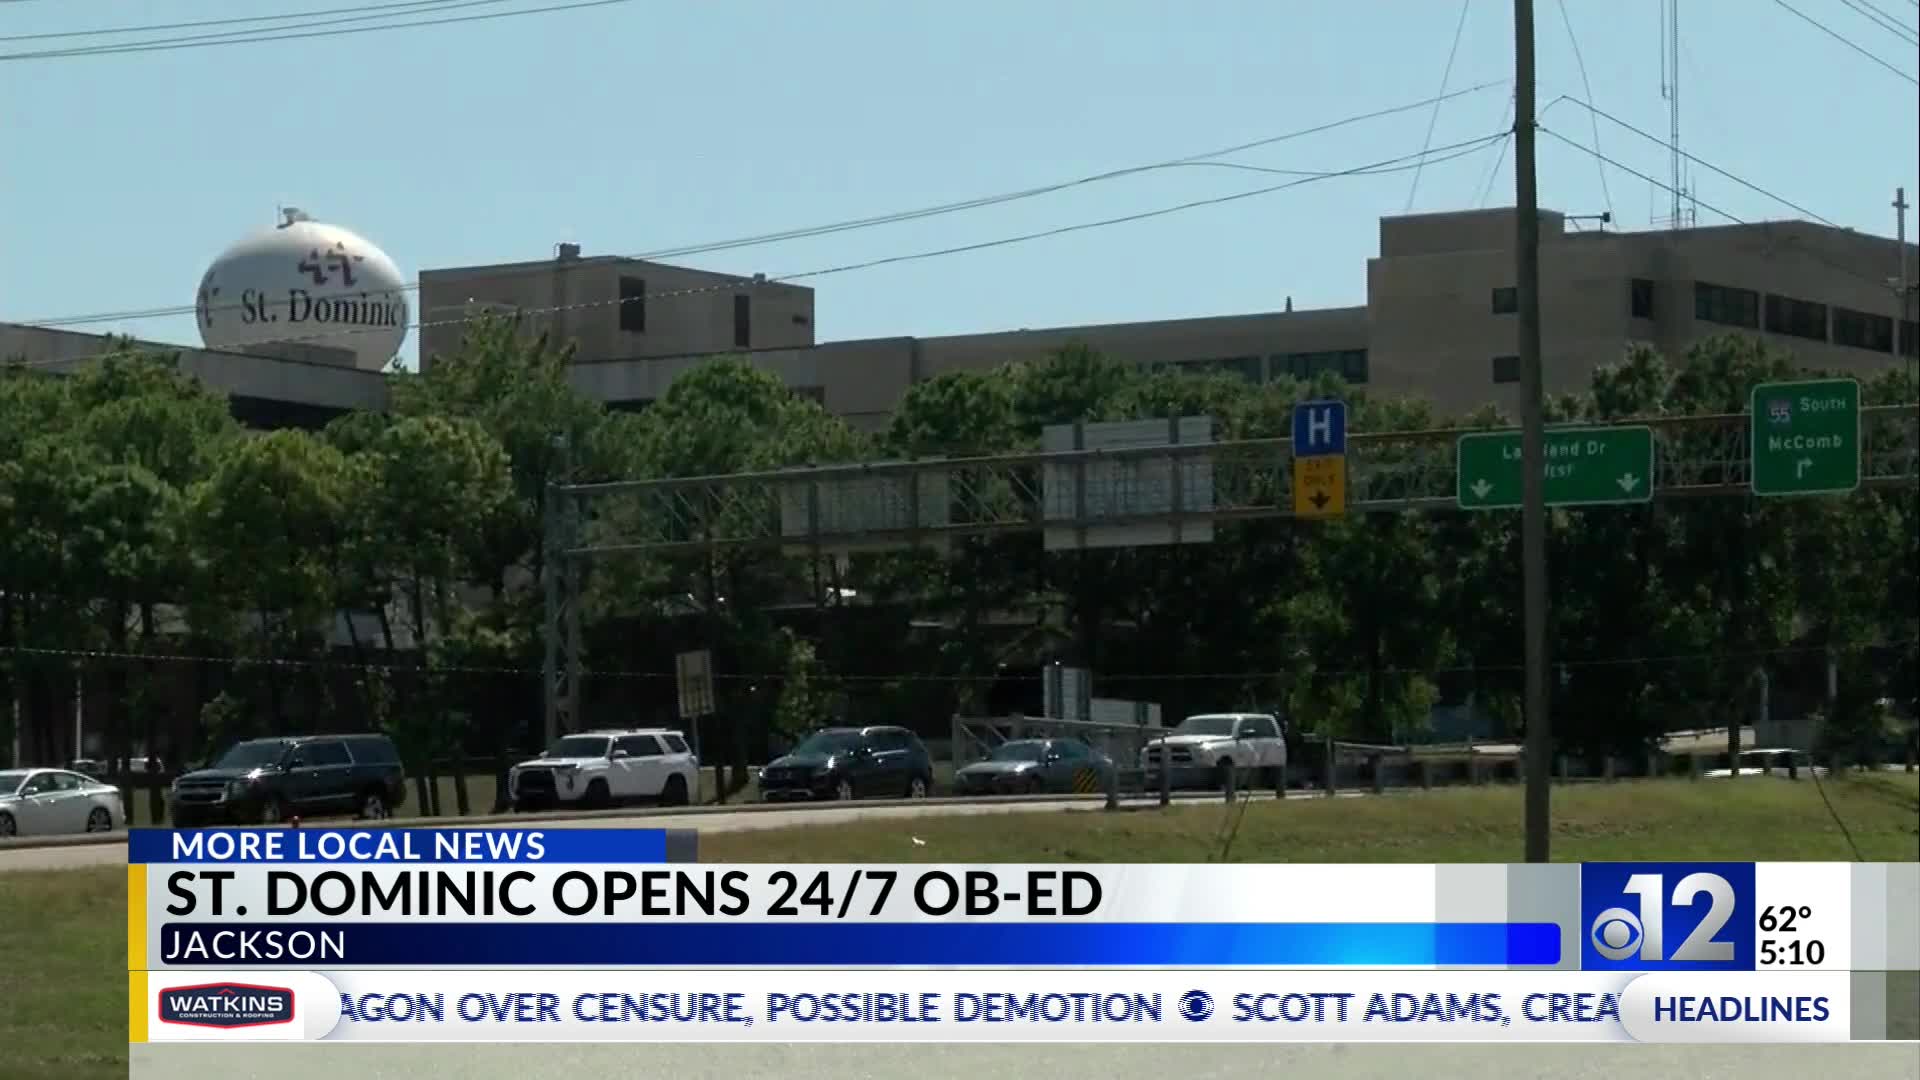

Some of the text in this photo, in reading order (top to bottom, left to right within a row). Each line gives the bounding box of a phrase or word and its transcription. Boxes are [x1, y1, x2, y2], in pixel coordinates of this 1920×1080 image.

[242, 287, 397, 327] St. Dominic
[1800, 397, 1847, 412] SOUTH
[1770, 407, 1792, 423] 55
[1308, 406, 1331, 446] H
[1502, 439, 1609, 461] Laland Dr
[1768, 434, 1844, 451] McComb
